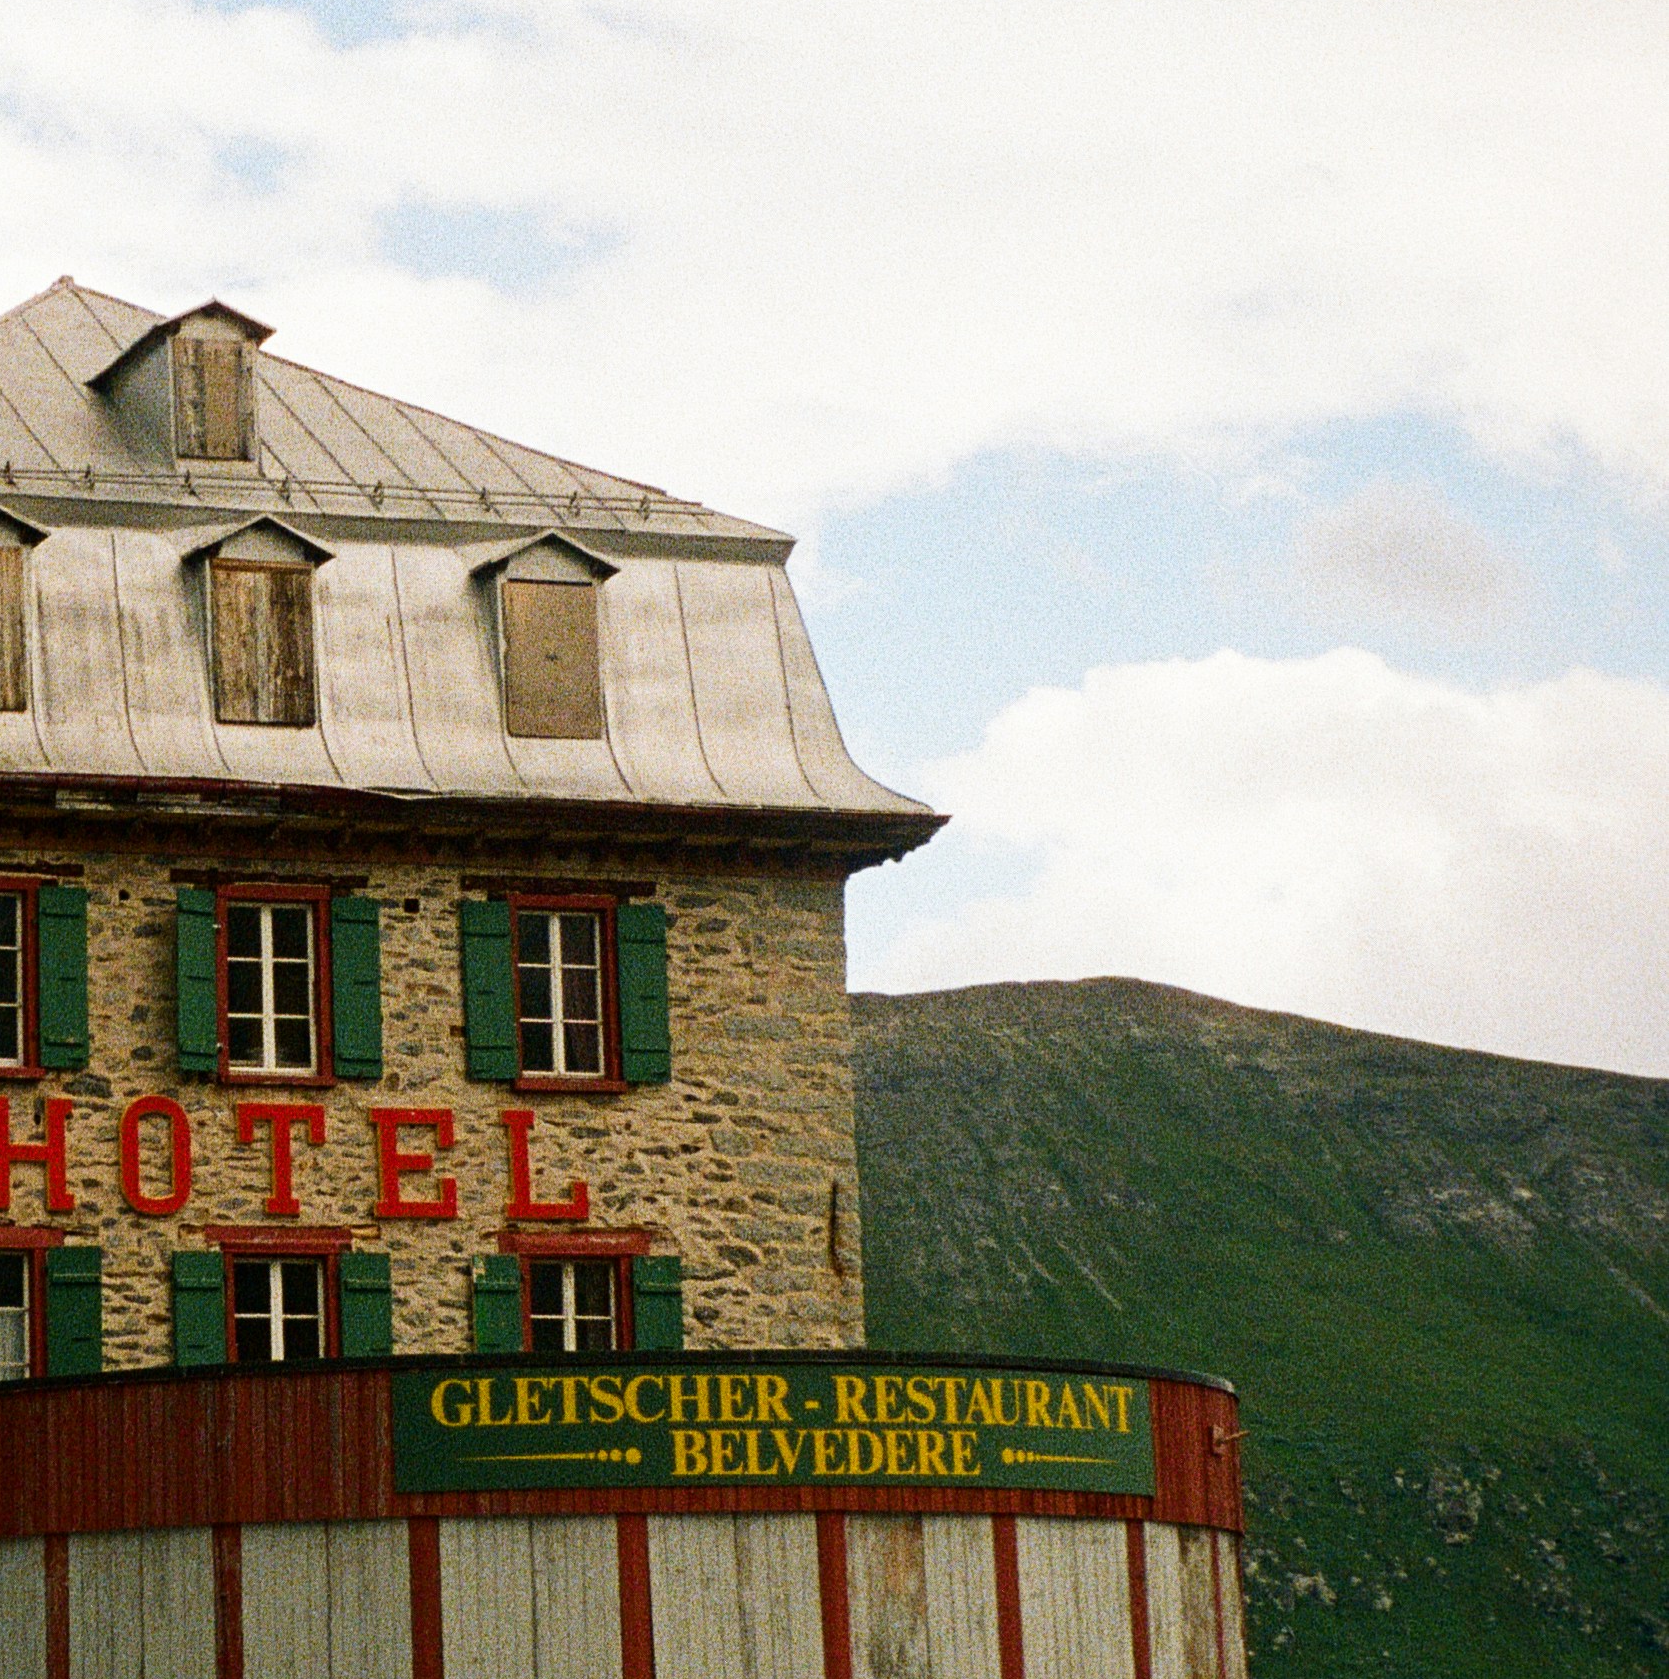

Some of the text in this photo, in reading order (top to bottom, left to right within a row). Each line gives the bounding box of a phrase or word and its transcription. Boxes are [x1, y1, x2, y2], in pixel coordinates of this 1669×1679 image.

[430, 1374, 792, 1426] GLETSCHER
[834, 1375, 1133, 1433] RESTAURANT
[670, 1429, 981, 1476] BELVEDERE
